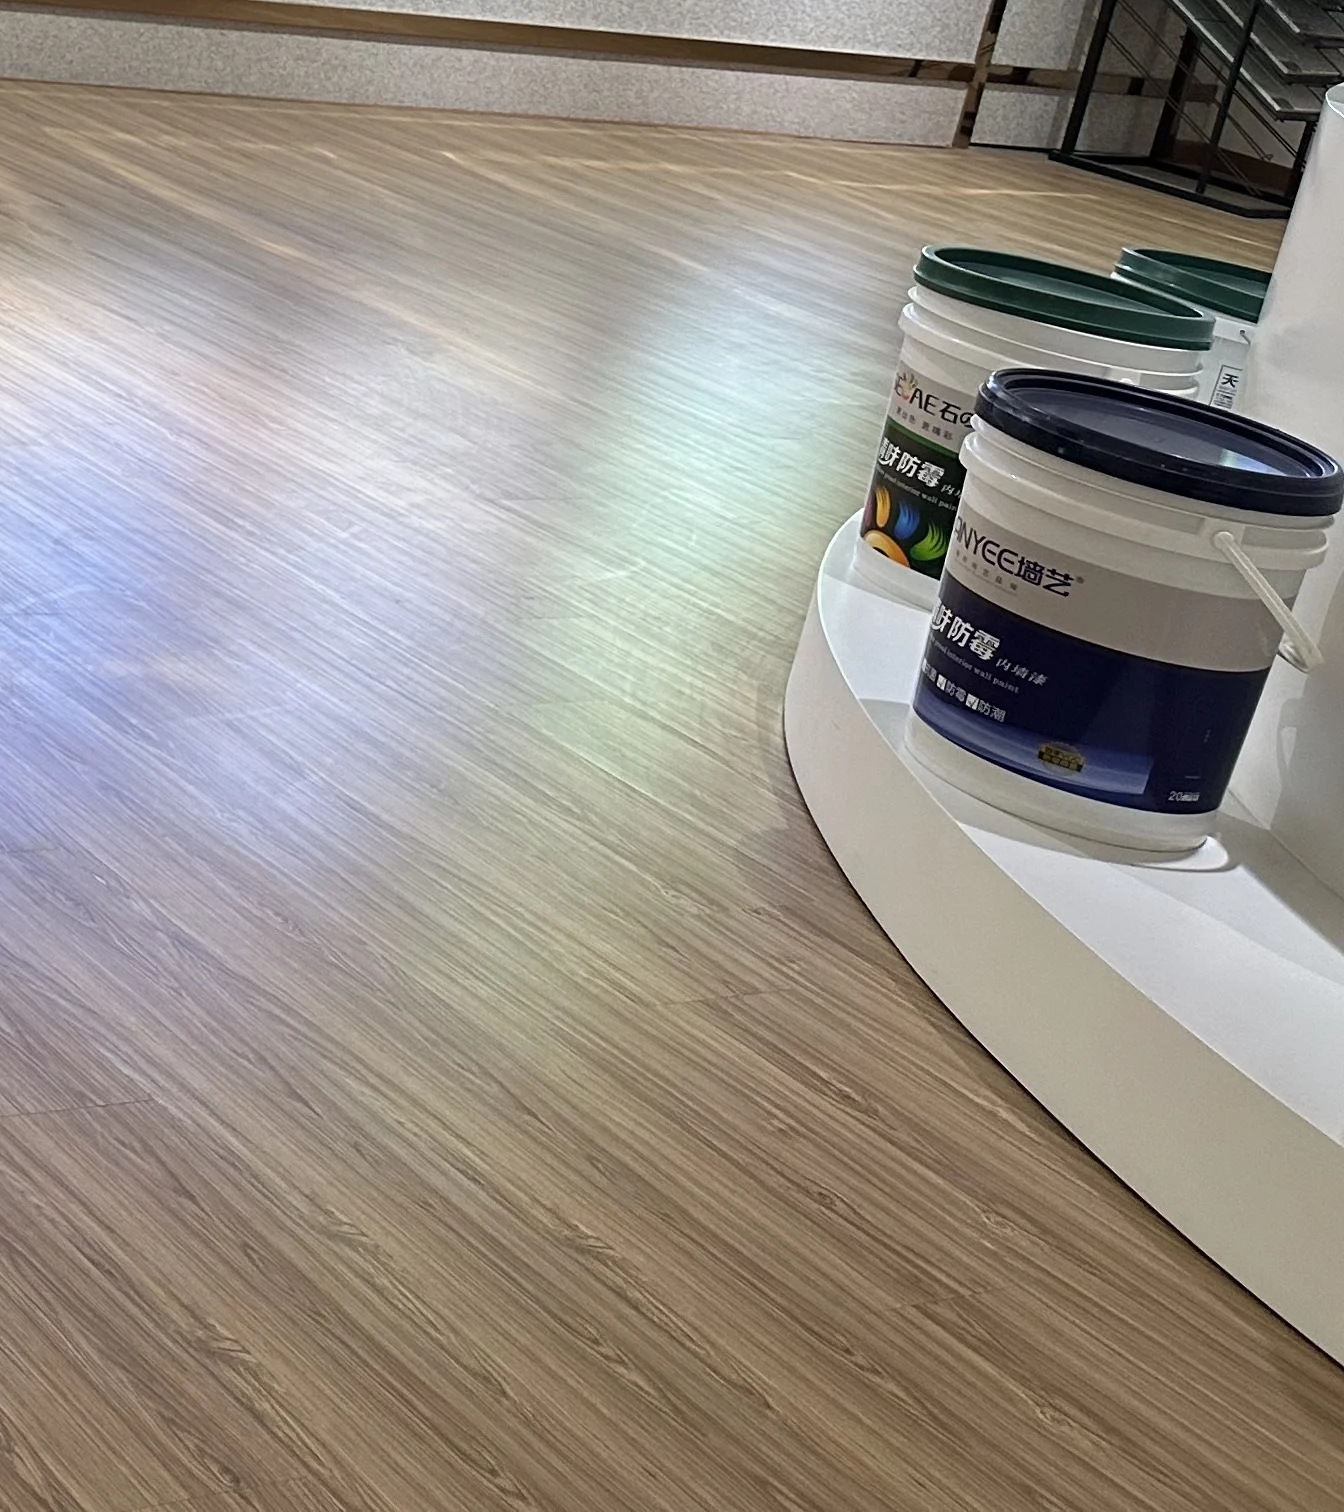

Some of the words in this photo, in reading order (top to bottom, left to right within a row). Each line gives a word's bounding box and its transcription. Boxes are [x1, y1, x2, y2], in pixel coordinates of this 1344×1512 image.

[1221, 373, 1239, 388] 天
[974, 666, 993, 681] wall
[993, 676, 1020, 694] paint
[996, 658, 1049, 686] 内墙漆
[978, 700, 1007, 723] 防潮
